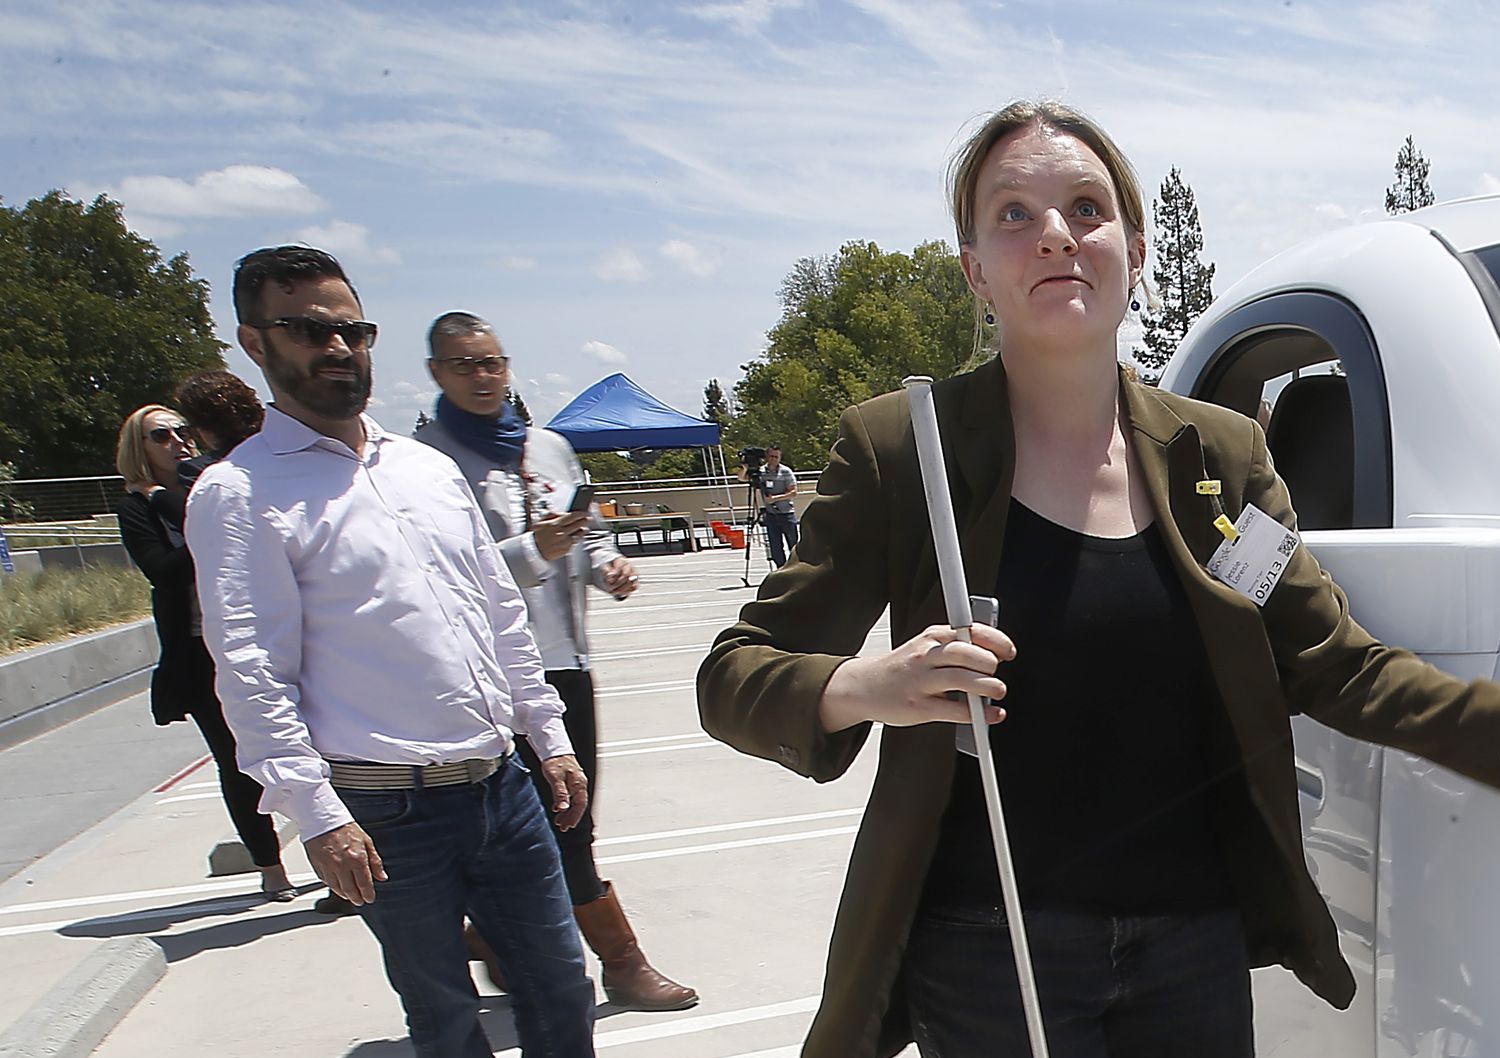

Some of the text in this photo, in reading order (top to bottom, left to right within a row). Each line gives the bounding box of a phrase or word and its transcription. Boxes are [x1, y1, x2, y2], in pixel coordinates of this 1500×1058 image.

[1238, 512, 1255, 533] Guest
[1225, 561, 1241, 581] Jessie
[1232, 562, 1249, 584] Lorenz
[1255, 561, 1282, 599] 05/13
